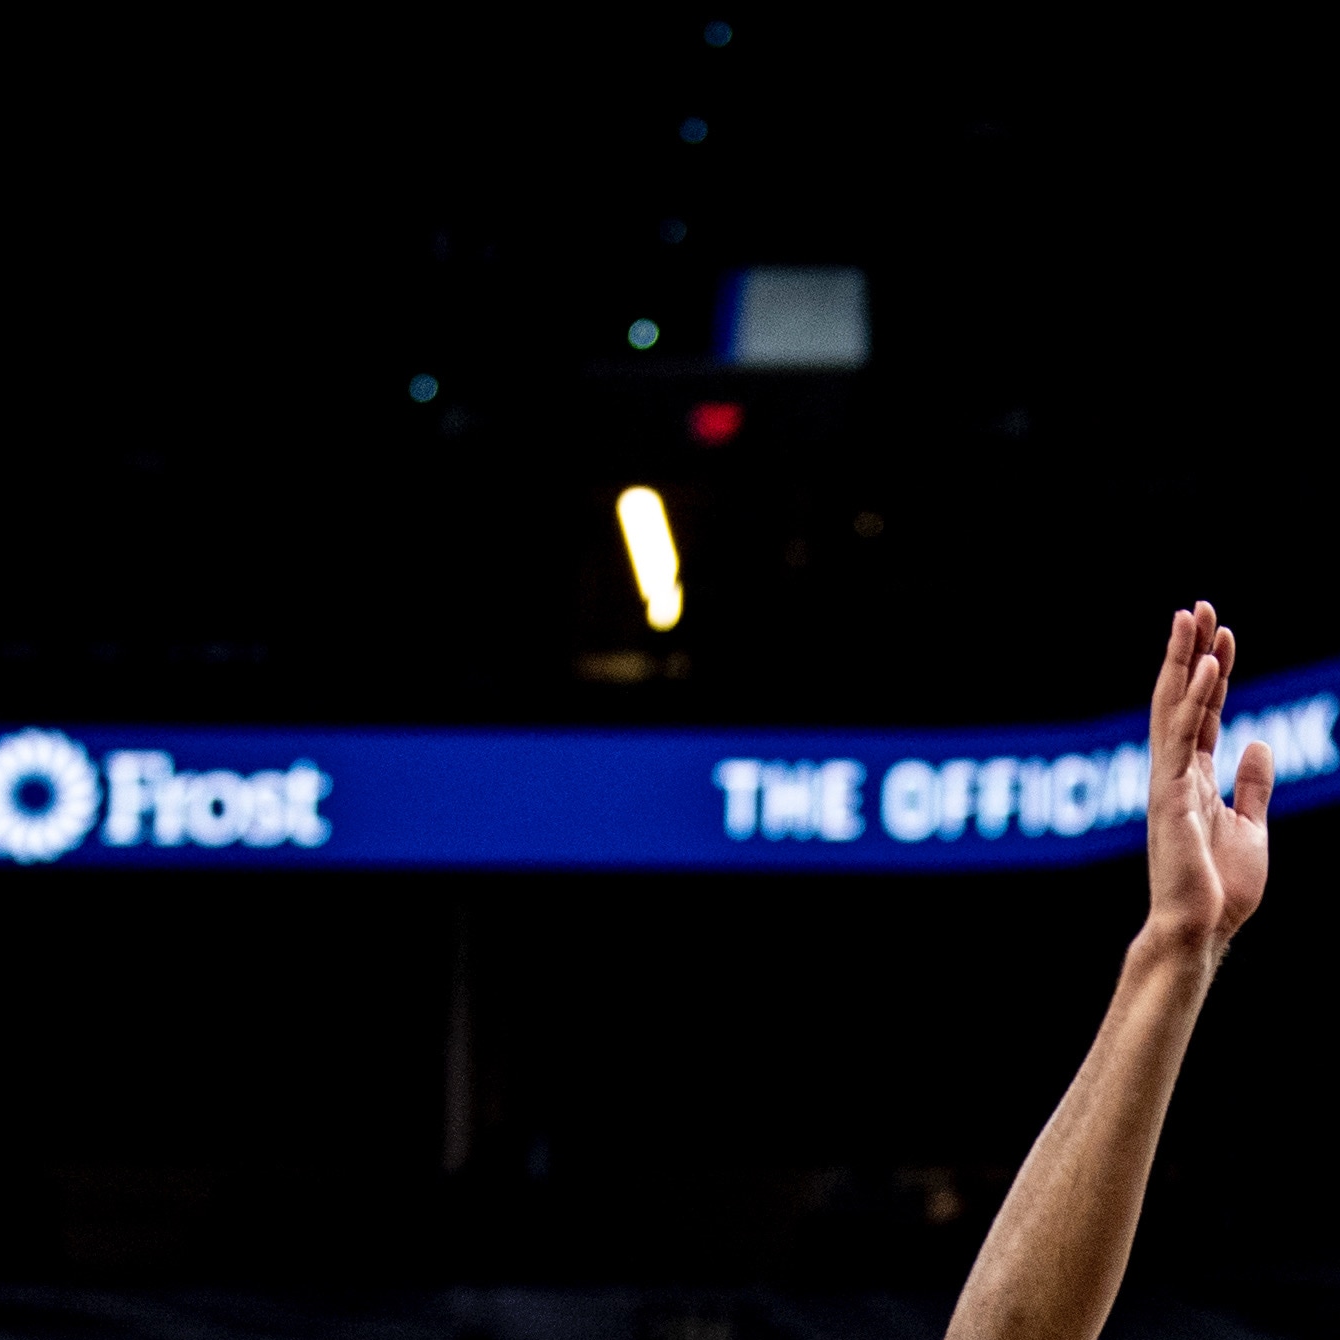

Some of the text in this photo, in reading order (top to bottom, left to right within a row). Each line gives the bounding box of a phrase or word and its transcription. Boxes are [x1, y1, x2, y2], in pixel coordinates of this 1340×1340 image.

[100, 749, 334, 848] Frost
[712, 755, 866, 842] THE
[879, 740, 1150, 842] OFFICIA
